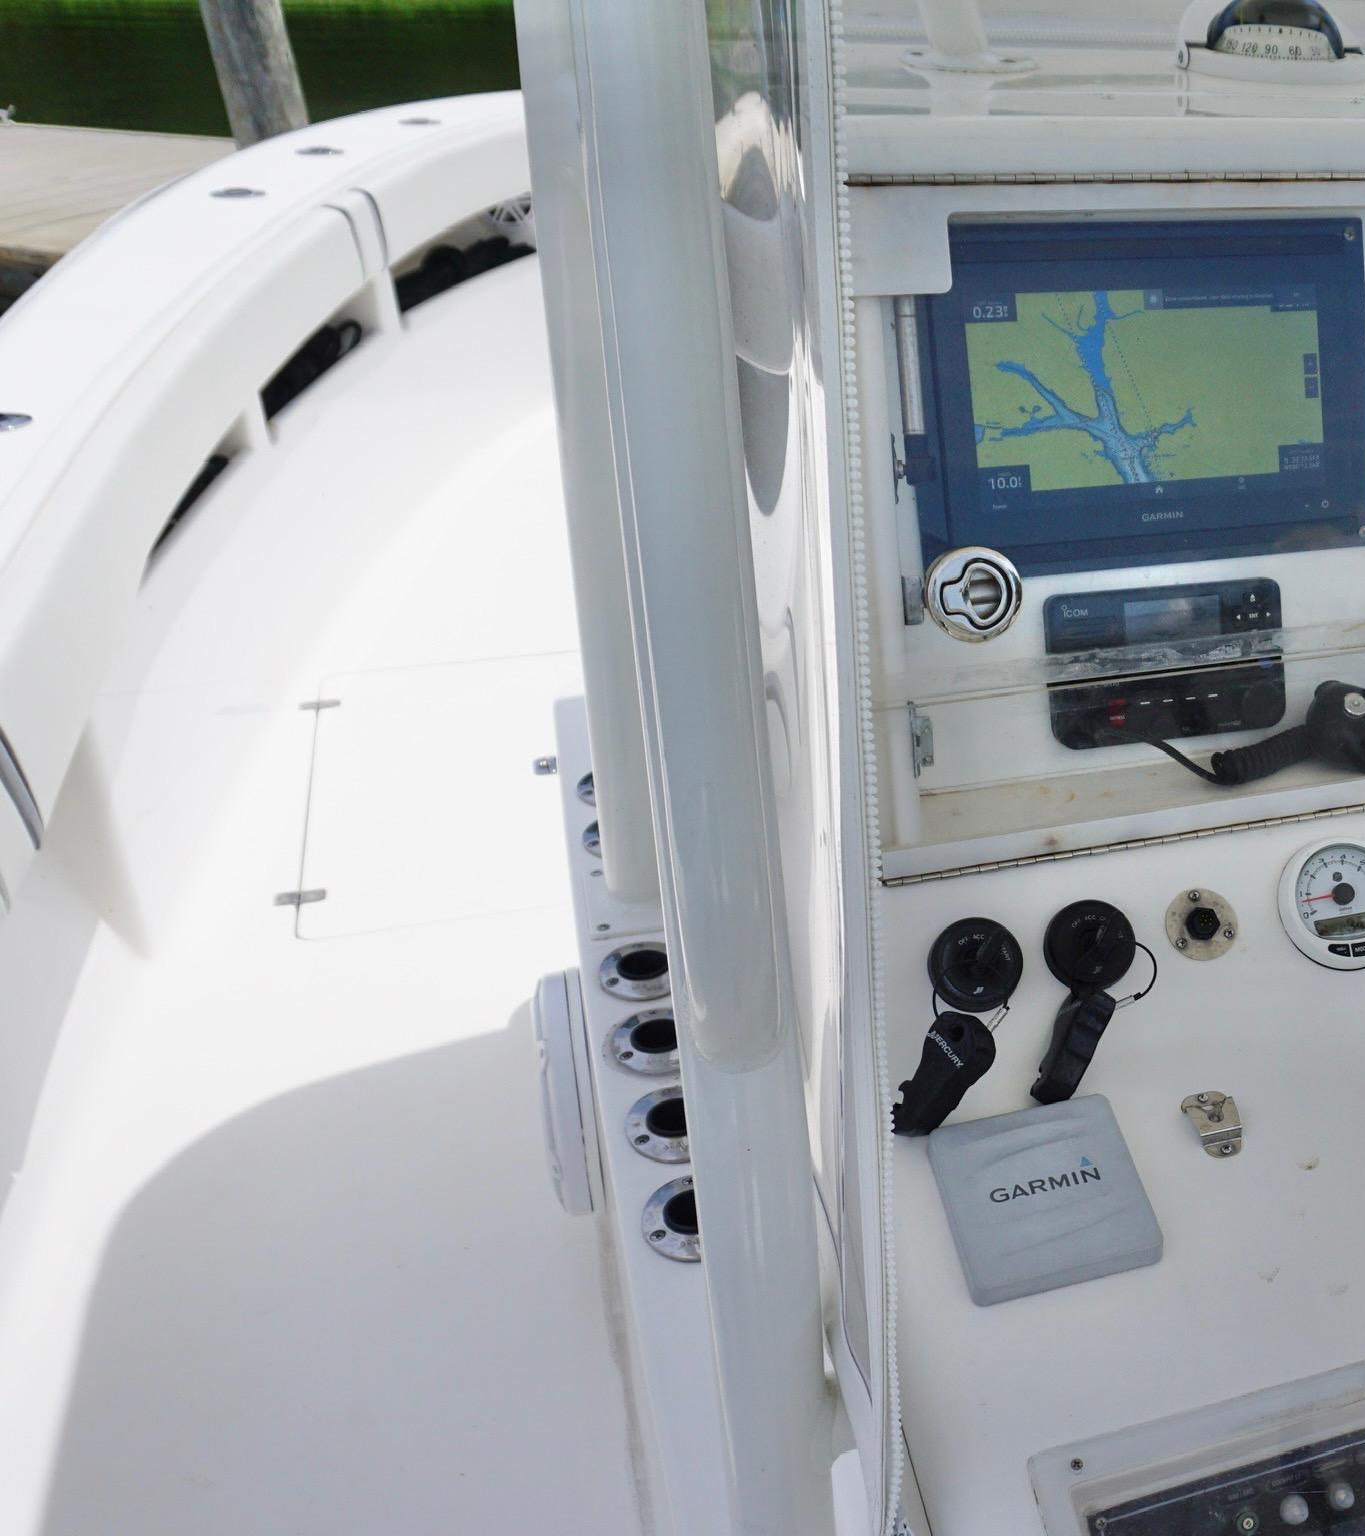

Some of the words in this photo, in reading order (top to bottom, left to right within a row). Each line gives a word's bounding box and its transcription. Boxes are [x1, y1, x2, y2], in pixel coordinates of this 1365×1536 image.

[1264, 44, 1278, 55] 90
[1141, 511, 1184, 522] GARMIN
[927, 1030, 964, 1069] MERCURY
[989, 1167, 1102, 1203] GARMIN
